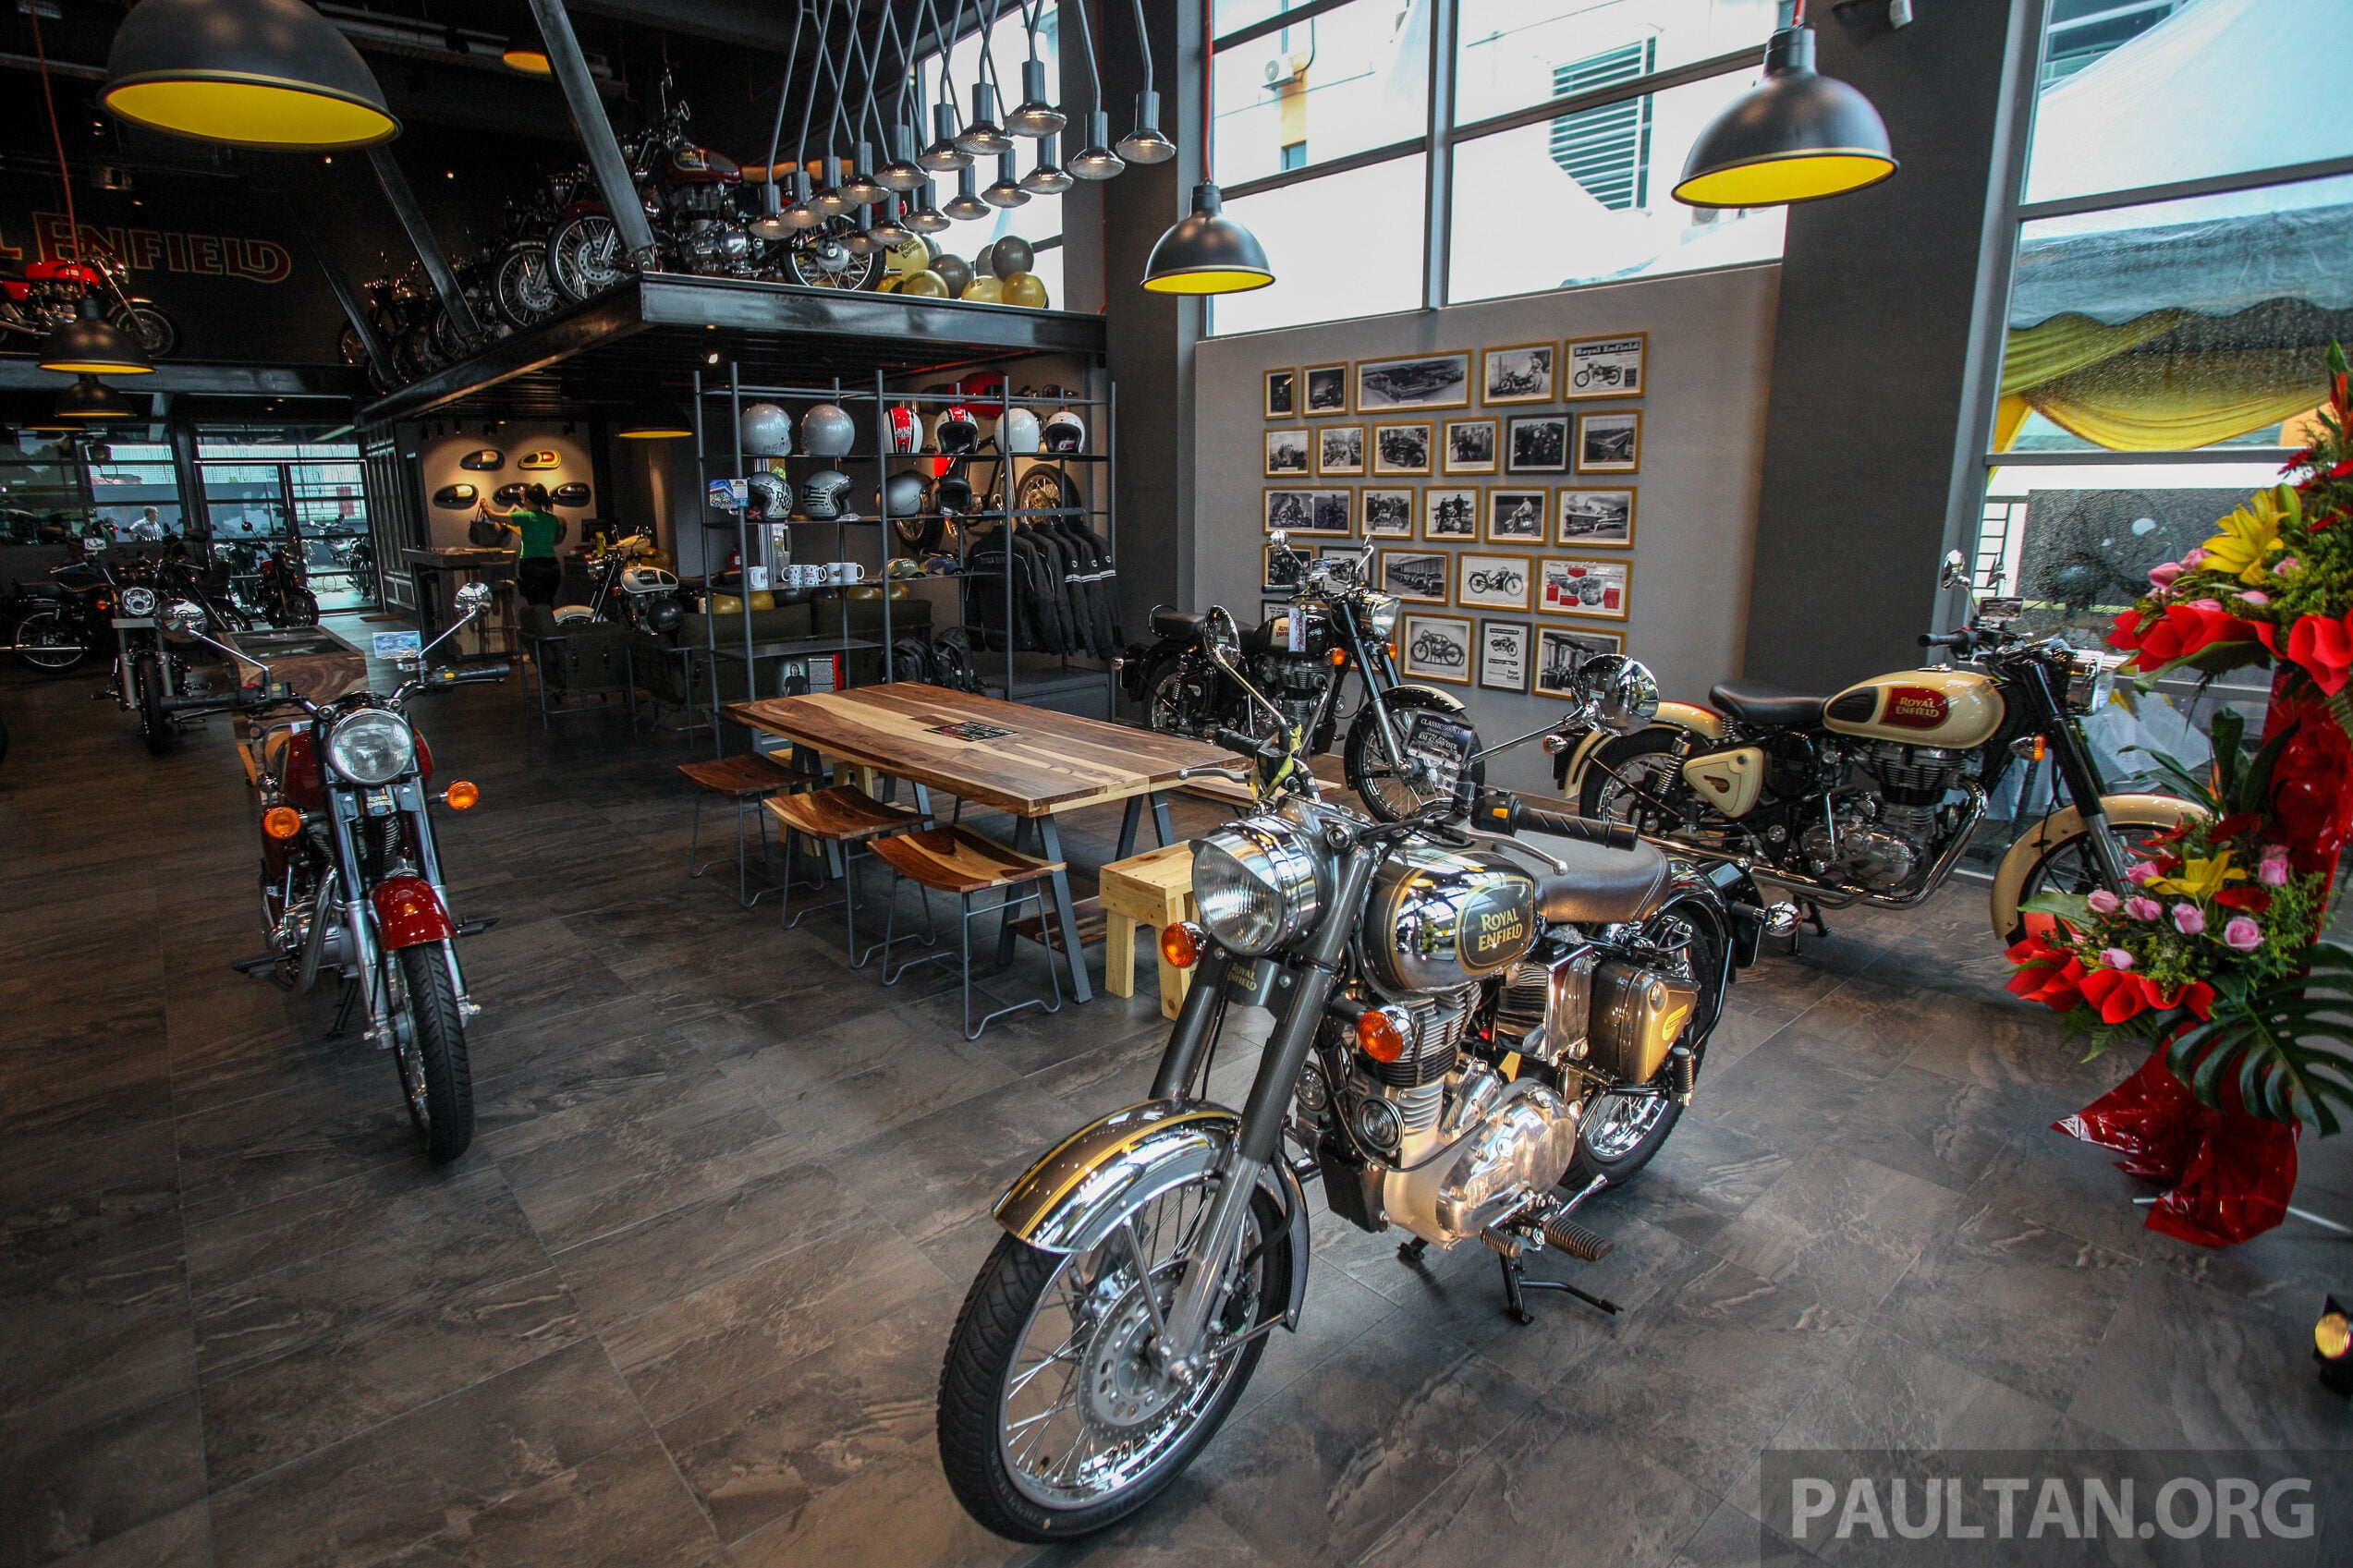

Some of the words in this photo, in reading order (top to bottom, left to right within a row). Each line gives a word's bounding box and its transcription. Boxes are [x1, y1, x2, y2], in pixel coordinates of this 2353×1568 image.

[32, 212, 291, 284] ENFIELD
[1576, 346, 1602, 356] Royal
[1603, 342, 1640, 353] Enfield
[1899, 697, 1935, 709] ROYAL
[1896, 706, 1940, 718] ENFIELD
[1420, 718, 1443, 730] CLASSIC
[1481, 907, 1519, 932] ROYAL
[1478, 922, 1523, 952] ENFIELD
[1230, 963, 1256, 980] ROYAL
